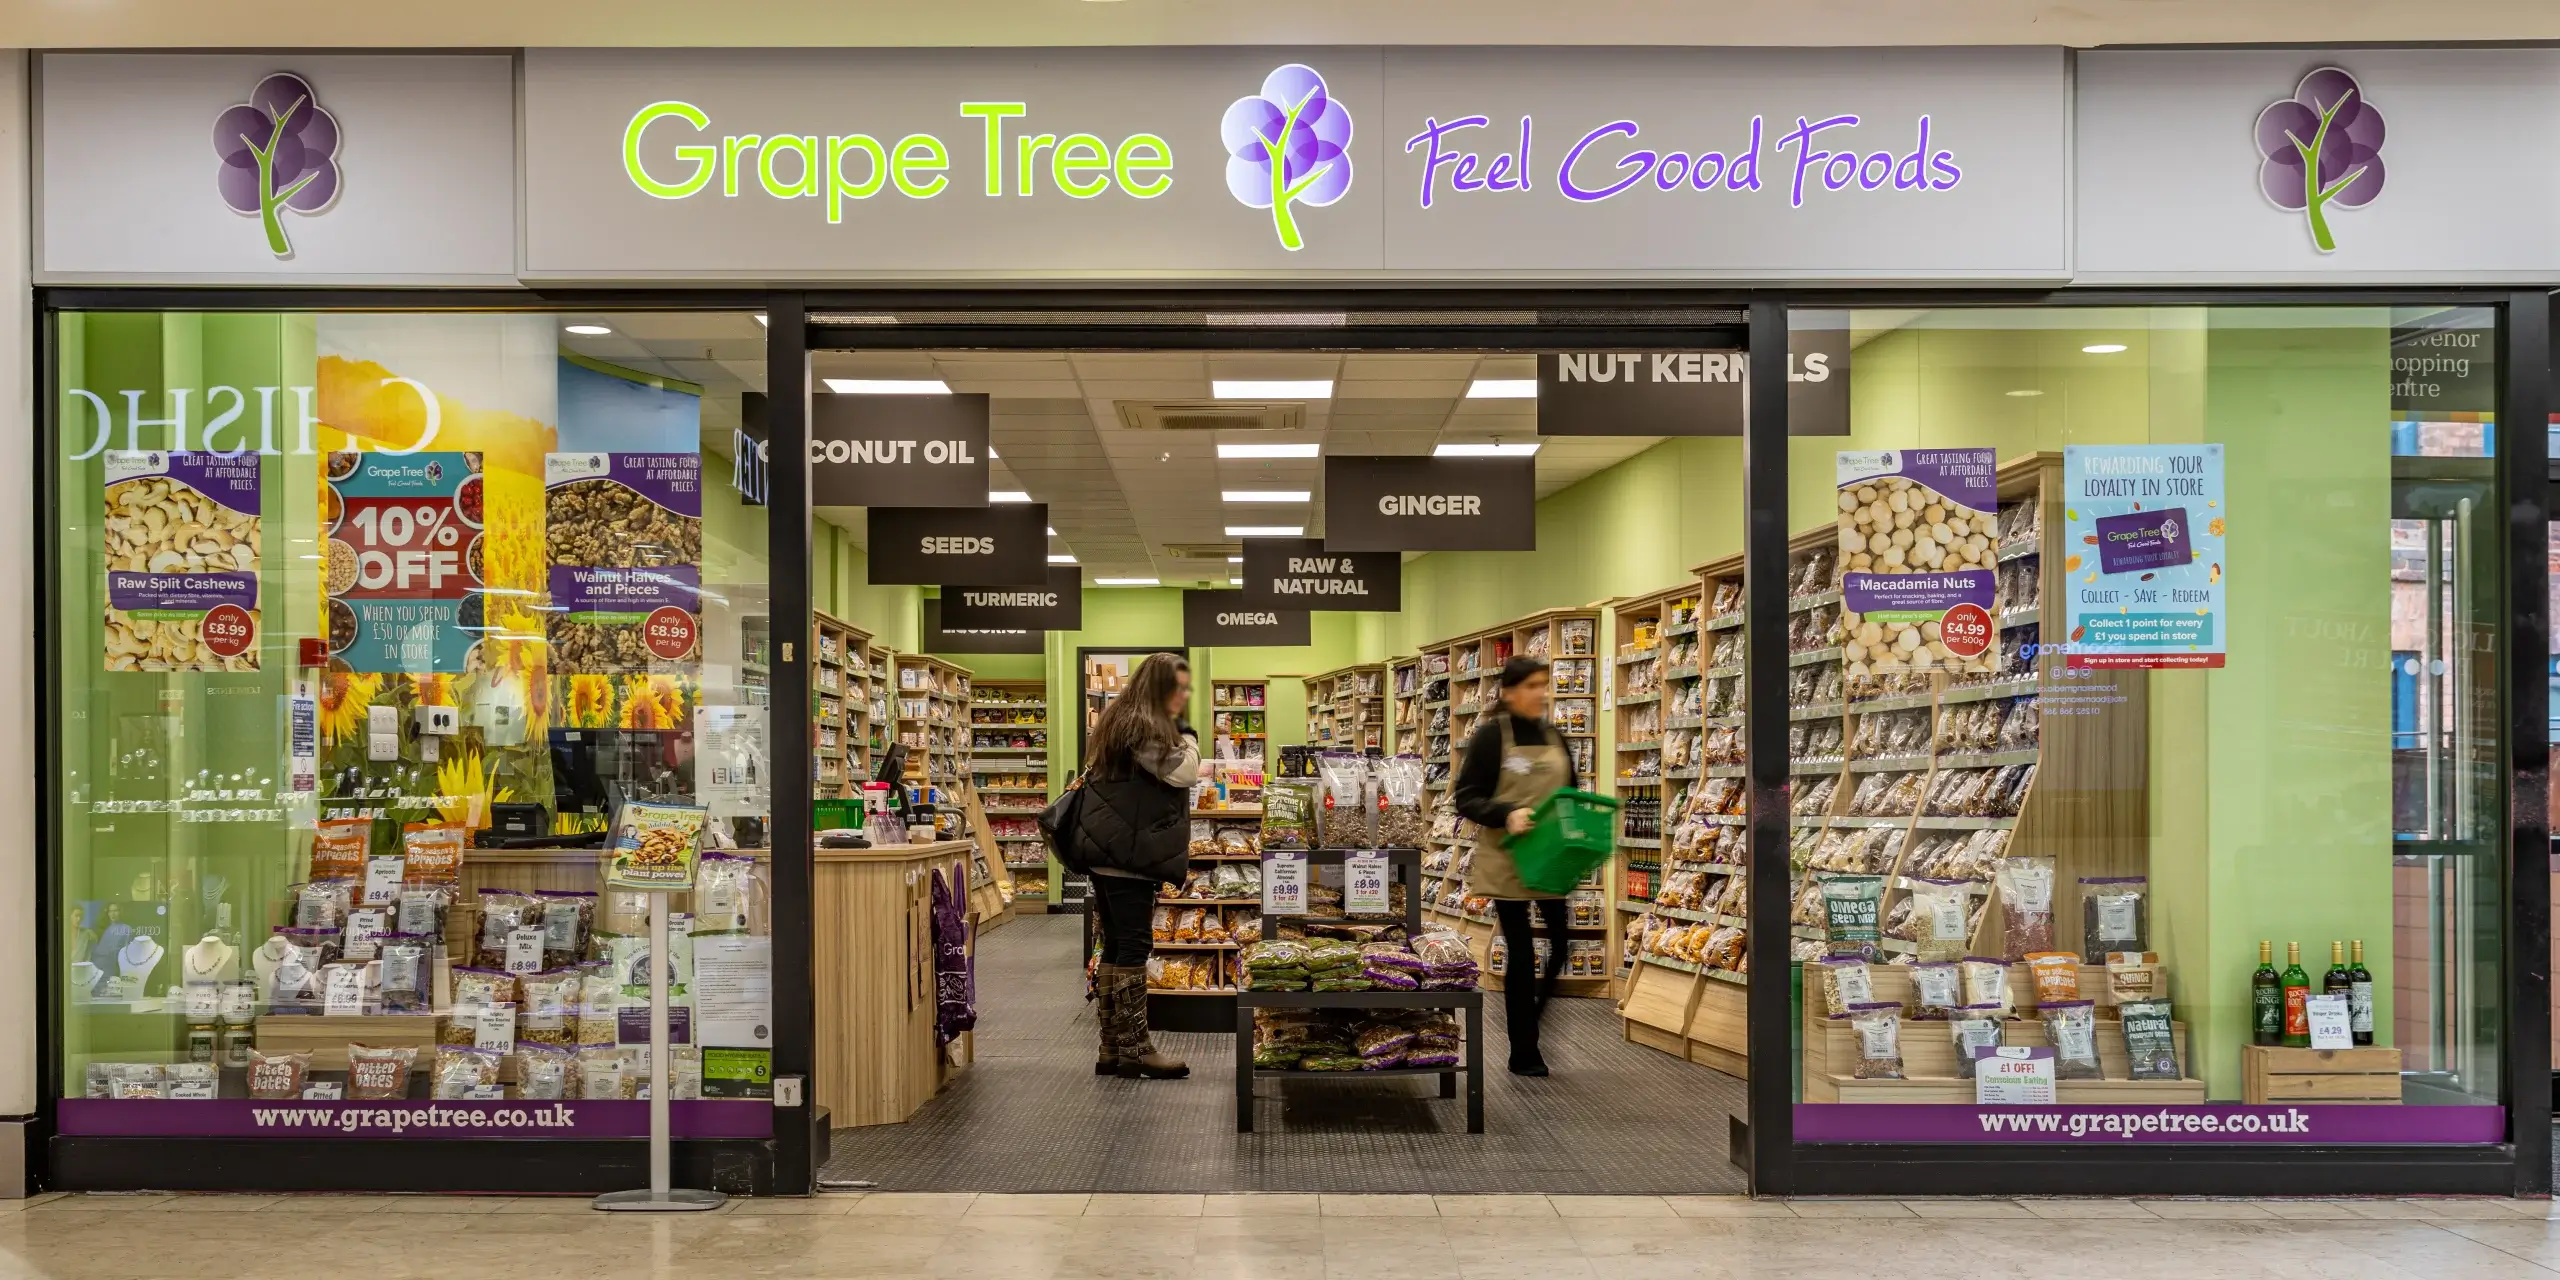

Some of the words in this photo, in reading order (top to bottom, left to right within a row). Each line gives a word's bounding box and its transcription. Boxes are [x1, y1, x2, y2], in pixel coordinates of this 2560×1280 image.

[623, 100, 950, 224] Grape
[960, 101, 1173, 198] Tree
[1405, 115, 1531, 209] Feel
[1558, 115, 1764, 203] Good
[1776, 114, 1963, 209] Foods
[2408, 333, 2480, 347] venor
[1558, 353, 1641, 383] NUT
[1652, 352, 1830, 383] KERNLS
[758, 439, 916, 465] CONUT
[923, 439, 975, 465] OIL
[1916, 453, 1938, 464] GREAT
[1940, 453, 1971, 464] TASTING
[207, 455, 236, 467] TASTING
[623, 456, 645, 468] GREAT
[647, 456, 678, 468] TASTING
[2084, 455, 2164, 476] REWARDING
[2168, 455, 2204, 474] YOUR
[205, 467, 214, 478] AT
[215, 467, 256, 479] AFFORDABLE
[368, 466, 400, 479] Grape
[401, 466, 423, 477] Tree
[646, 470, 655, 480] AT
[656, 469, 697, 480] AFFORDABLE
[1939, 465, 1949, 476] AT
[1950, 464, 1992, 476] AFFORDABLE
[230, 479, 256, 490] PRICES.
[671, 481, 697, 492] PRICES.
[1965, 477, 1992, 488] PRICES.
[2084, 478, 2137, 497] LOYALTY
[2142, 478, 2160, 496] IN
[2166, 478, 2204, 496] STORE
[1378, 494, 1481, 517] GINGER
[352, 506, 459, 547] 10%
[2107, 530, 2138, 542] Grape
[2138, 528, 2160, 539] Tree
[920, 536, 995, 555] SEEDS
[358, 551, 459, 589] OFF
[1288, 557, 1336, 574] RAW
[1340, 557, 1354, 574] &
[117, 577, 146, 589] Raw
[150, 577, 181, 591] Split
[184, 577, 246, 590] Cashews
[574, 572, 622, 583] Walnut
[625, 572, 671, 583] Halves
[1860, 578, 1939, 591] Macadamia
[1943, 577, 1976, 589] Nuts
[585, 584, 611, 595] and
[615, 584, 659, 595] Pieces
[1273, 578, 1369, 595] NATURAL
[963, 592, 1058, 607] TURMERIC
[2081, 589, 2120, 604] COLLECT
[2134, 588, 2157, 603] SAVE
[2172, 588, 2210, 603] REDEEM
[218, 613, 239, 623] only
[363, 605, 394, 621] WHEN
[396, 605, 416, 621] YOU
[419, 605, 450, 621] SPEND
[1216, 612, 1278, 626] OMEGA
[1957, 612, 1978, 623] only
[660, 616, 681, 626] only
[2089, 618, 2123, 628] Collect
[2125, 618, 2131, 628] 1
[2132, 618, 2158, 630] point
[2160, 617, 2174, 628] for
[2175, 619, 2203, 630] every
[208, 623, 247, 637] £8.99
[373, 623, 393, 640] £50
[397, 625, 408, 640] OR
[411, 625, 440, 640] MORE
[650, 625, 689, 639] £8.99
[1947, 622, 1986, 635] £4.99
[213, 638, 227, 646] per
[229, 637, 240, 646] kg
[656, 640, 670, 648] per
[671, 639, 682, 648] kg
[1946, 636, 1961, 645] per
[1962, 635, 1984, 646] 500g
[2094, 631, 2106, 641] £1
[2107, 633, 2126, 643] you
[2128, 631, 2159, 643] spend
[2160, 631, 2170, 640] in
[2171, 631, 2197, 641] store
[384, 644, 398, 659] IN
[401, 644, 429, 660] STORE
[2084, 657, 2098, 665] Sign
[2159, 656, 2188, 665] collecting
[2189, 656, 2209, 664] today!
[679, 810, 704, 821] Tree
[622, 869, 650, 877] plant
[652, 871, 686, 879] power
[1272, 884, 1299, 895] £9.99
[1354, 879, 1380, 889] £8.99
[511, 961, 537, 971] £8.99
[2319, 1027, 2342, 1035] £4.29
[480, 1040, 509, 1050] £12.49
[2000, 1063, 2010, 1073] £1
[2014, 1062, 2035, 1074] OFF!
[1985, 1075, 2021, 1084] Conscious
[2024, 1075, 2048, 1085] Eating
[252, 1104, 575, 1133] www.grapetree.co.uk
[1978, 1108, 2309, 1138] www.grapetree.co.uk
